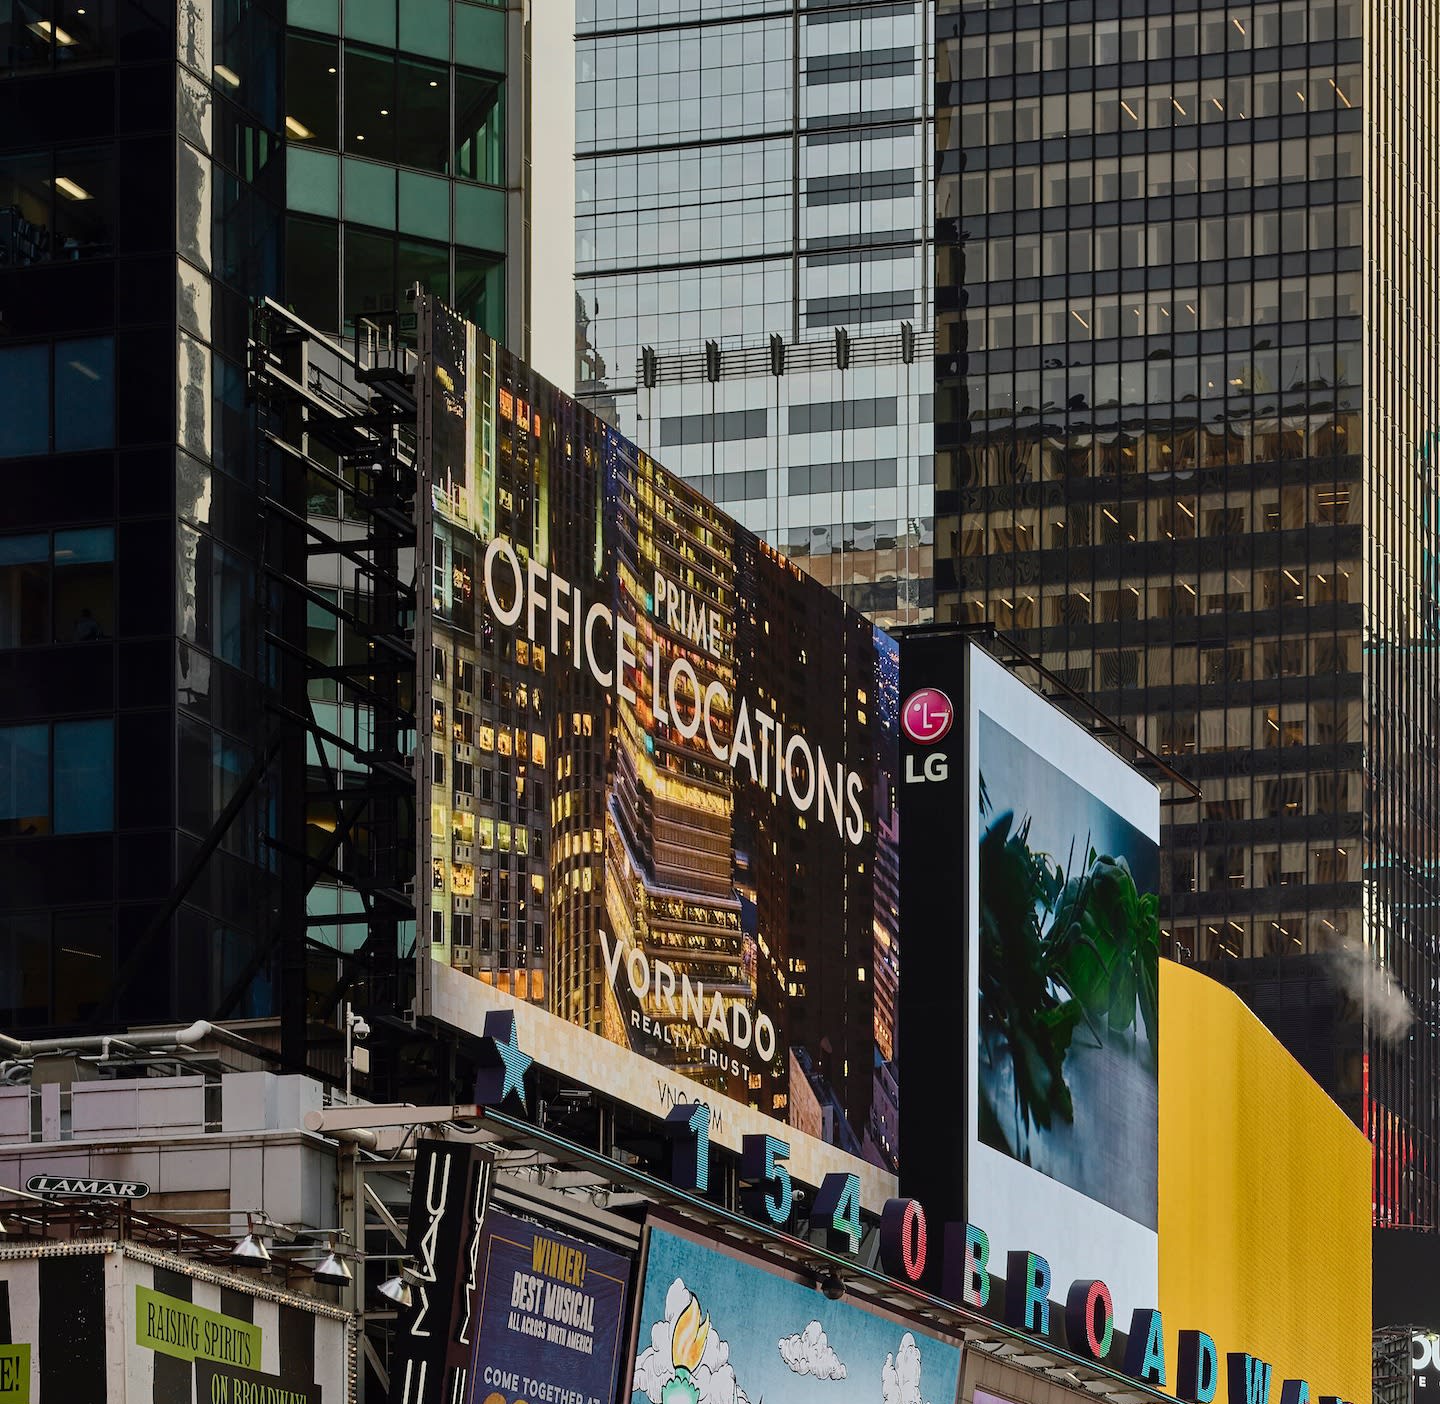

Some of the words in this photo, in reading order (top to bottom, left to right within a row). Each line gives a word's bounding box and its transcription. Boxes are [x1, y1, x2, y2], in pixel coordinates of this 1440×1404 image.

[653, 570, 724, 659] PRIME
[484, 537, 637, 704] OFFICE
[653, 657, 865, 845] LOCATIONS
[906, 753, 949, 784] LG
[598, 929, 777, 1062] VORNADO
[631, 1011, 692, 1054] REALTY
[699, 1044, 751, 1080] TRUST
[36, 1178, 138, 1198] LAMAR
[688, 1104, 928, 1281] 1540
[532, 1235, 587, 1288] WINNER!
[508, 1312, 521, 1330] ALL
[521, 1316, 546, 1340] ACROSS
[567, 1329, 593, 1355] AMERICA
[511, 1270, 543, 1315] BEST
[544, 1282, 595, 1333] MUSICAL
[146, 1302, 200, 1351] RAISING
[204, 1322, 252, 1367] SPIRITS
[483, 1366, 519, 1391] COME
